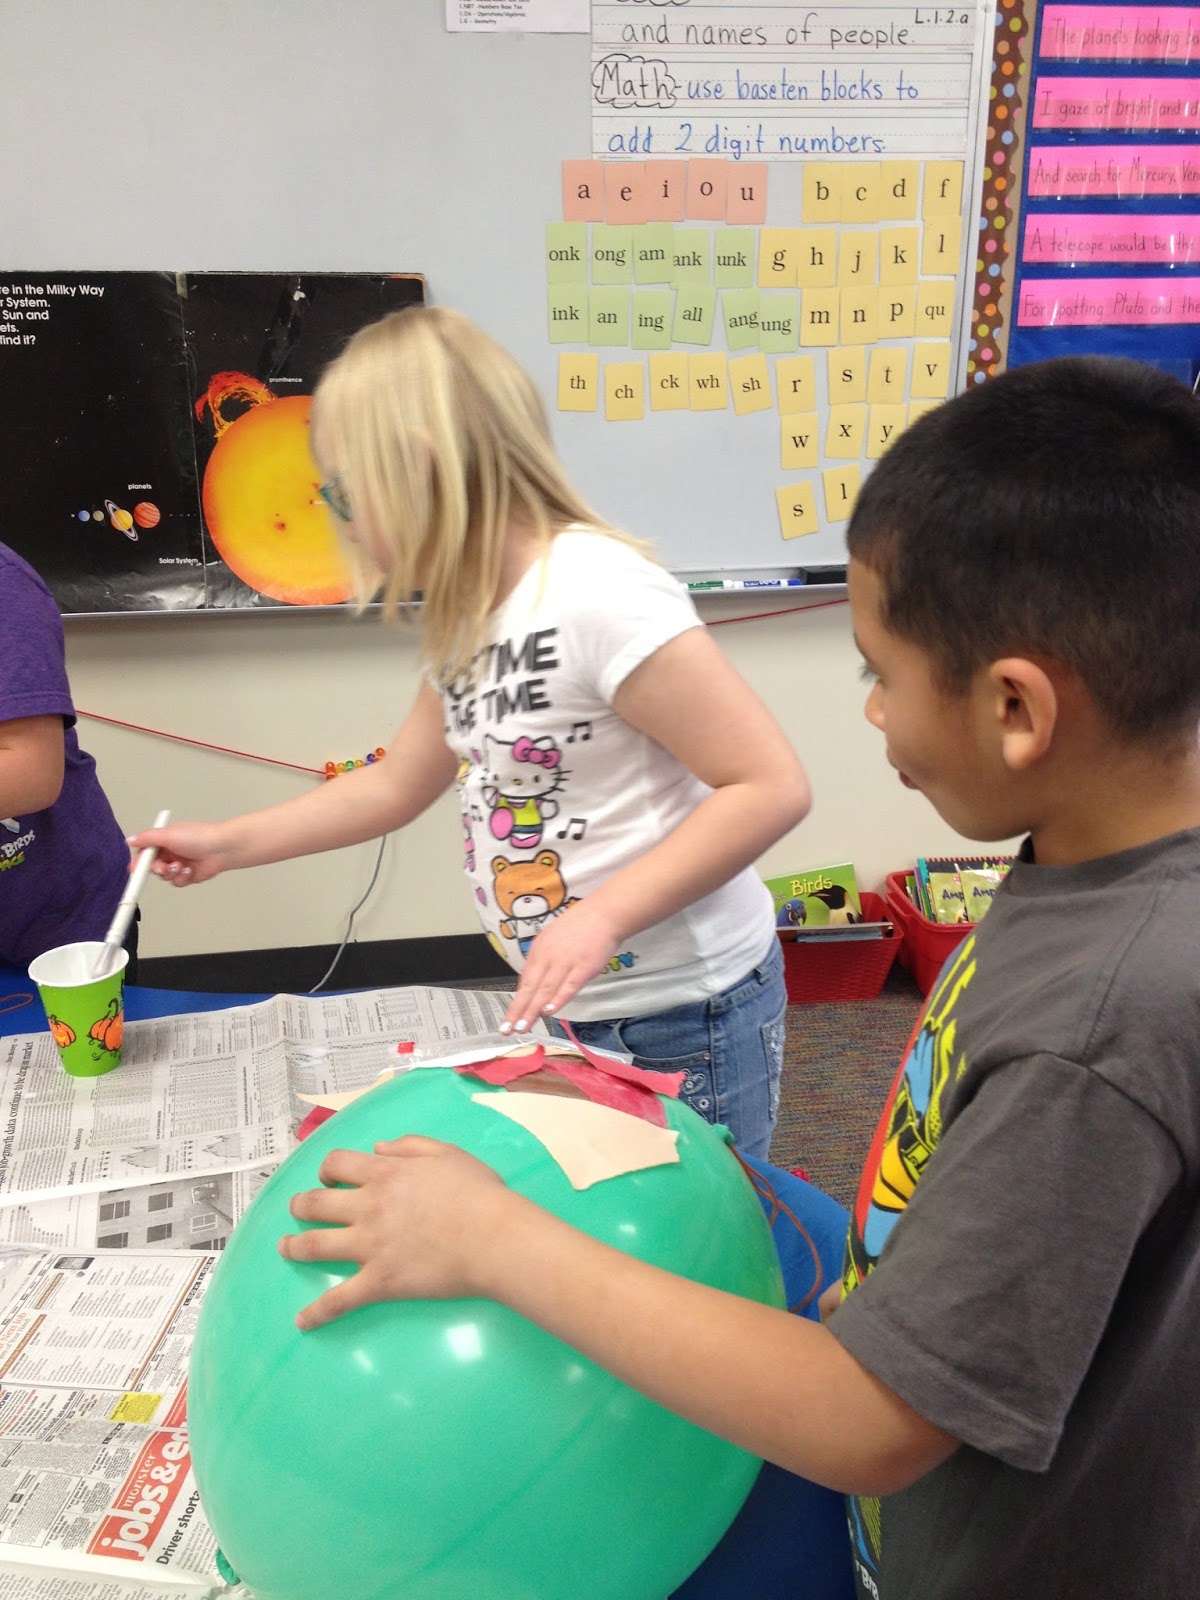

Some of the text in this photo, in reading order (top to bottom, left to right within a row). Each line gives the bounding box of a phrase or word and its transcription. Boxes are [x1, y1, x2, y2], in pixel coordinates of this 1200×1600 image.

[621, 13, 915, 50] and names of people.
[1052, 18, 1075, 45] The
[821, 69, 883, 100] blocks
[896, 70, 918, 100] to
[1040, 90, 1053, 117] I
[1059, 103, 1089, 122] gaze
[1159, 99, 1181, 116] and
[608, 126, 653, 154] add
[674, 123, 693, 151] 2
[705, 124, 765, 160] digit
[1034, 158, 1061, 184] And
[1065, 160, 1101, 183] search
[577, 180, 754, 201] a e i o u
[815, 178, 950, 201] b c d f
[1030, 228, 1043, 252] A
[1110, 232, 1146, 252] would
[1154, 234, 1167, 251] be
[549, 246, 747, 267] onk ong am ank unk
[771, 249, 787, 272] g
[810, 246, 824, 266] h
[851, 250, 861, 274] j
[893, 245, 907, 264] k
[11, 284, 23, 295] in
[24, 284, 44, 295] the
[46, 284, 76, 297] Milky
[78, 284, 105, 297] Way
[2, 310, 50, 320] Sun and
[6, 297, 51, 310] System.
[809, 302, 945, 325] m n p qu
[1023, 294, 1045, 318] For
[1112, 290, 1145, 316] Pluto
[1150, 295, 1173, 315] and
[552, 306, 791, 336] ink an ing all ang ung
[22, 335, 37, 345] it?
[570, 374, 761, 399] th ch ck wh sh
[791, 363, 938, 393] r s t v
[791, 424, 894, 449] w x y
[792, 504, 804, 518] s
[175, 557, 199, 567] System
[482, 678, 553, 724] TIME
[789, 873, 833, 897] Birds
[4, 1118, 17, 1135] data
[122, 1451, 156, 1508] monster
[156, 1530, 184, 1565] Driver
